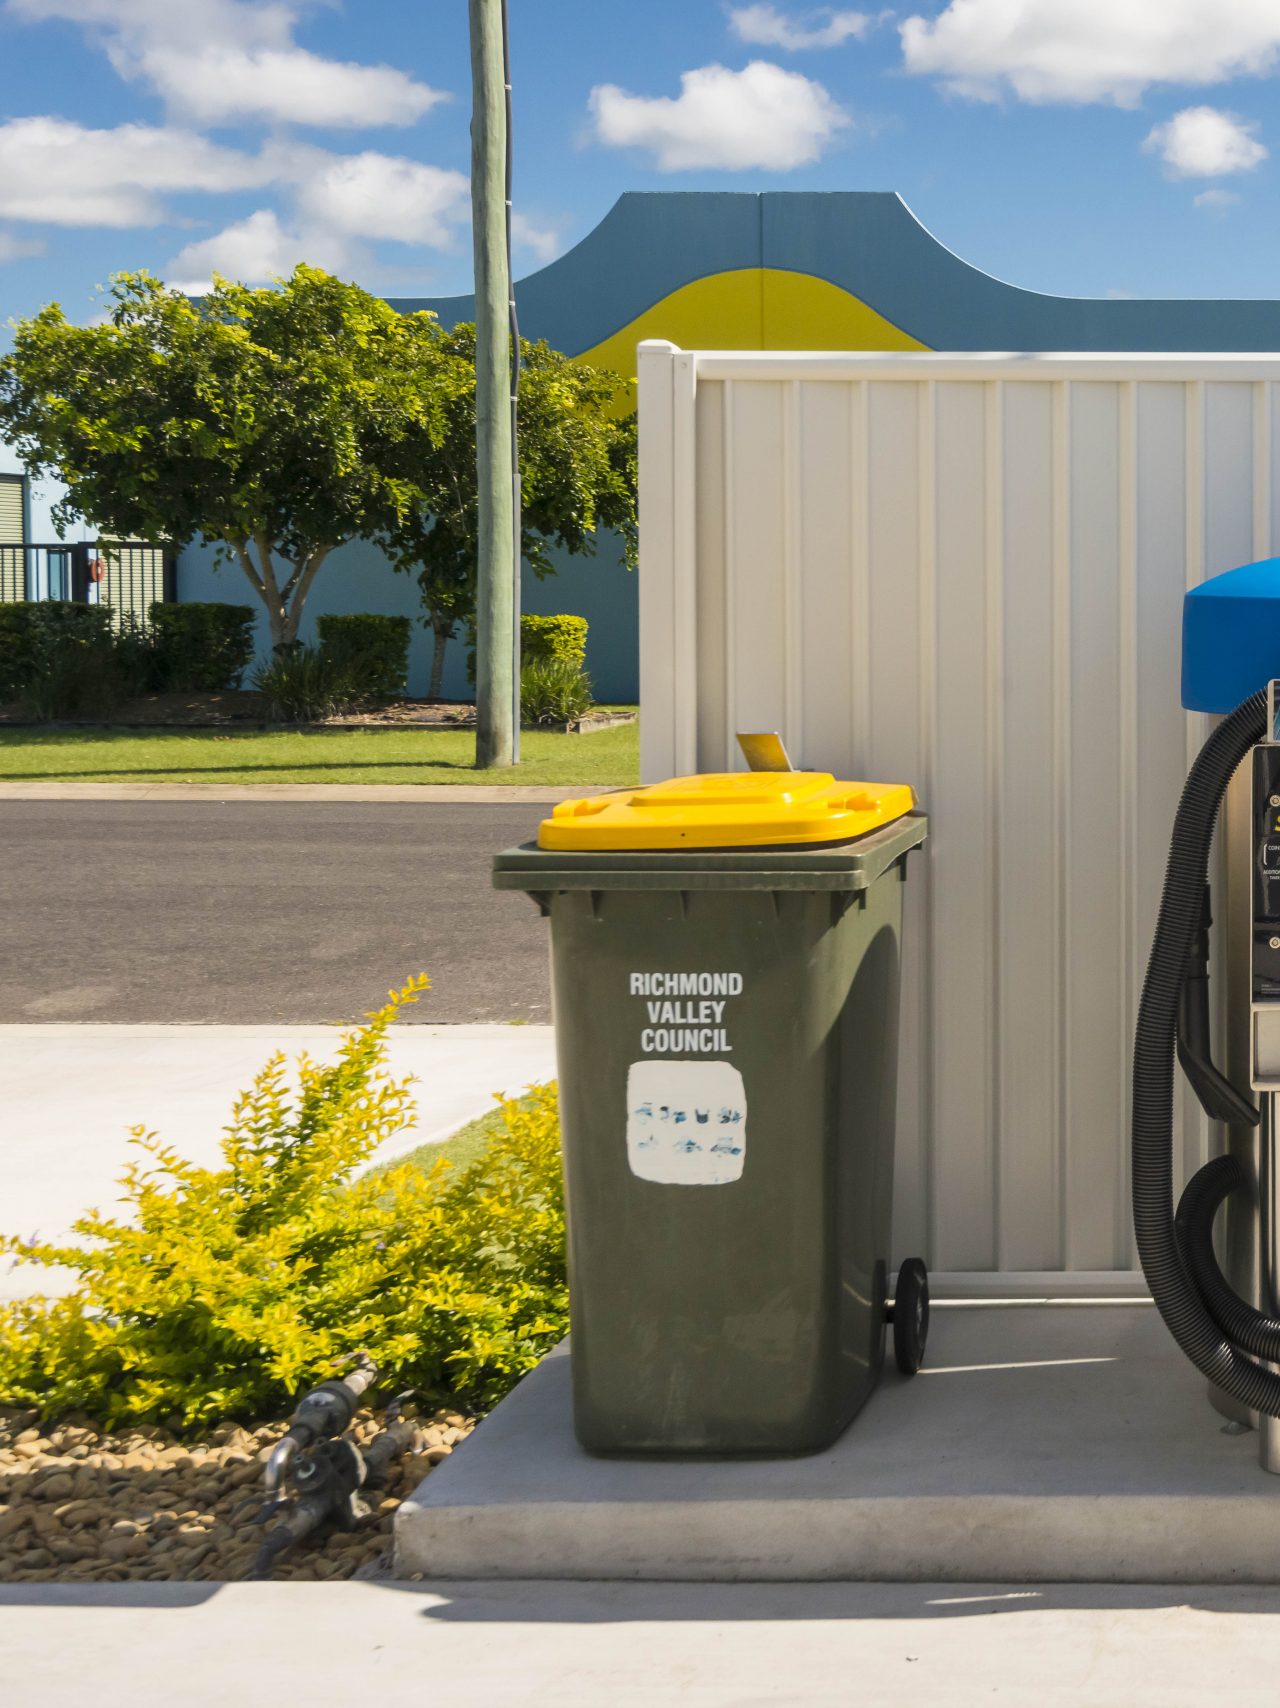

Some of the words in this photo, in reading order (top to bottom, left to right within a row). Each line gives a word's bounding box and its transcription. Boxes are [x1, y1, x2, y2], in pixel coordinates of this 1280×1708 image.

[629, 972, 743, 996] RICHMOND
[646, 1001, 726, 1024] VALLEY
[641, 1028, 733, 1052] COUNCIL
